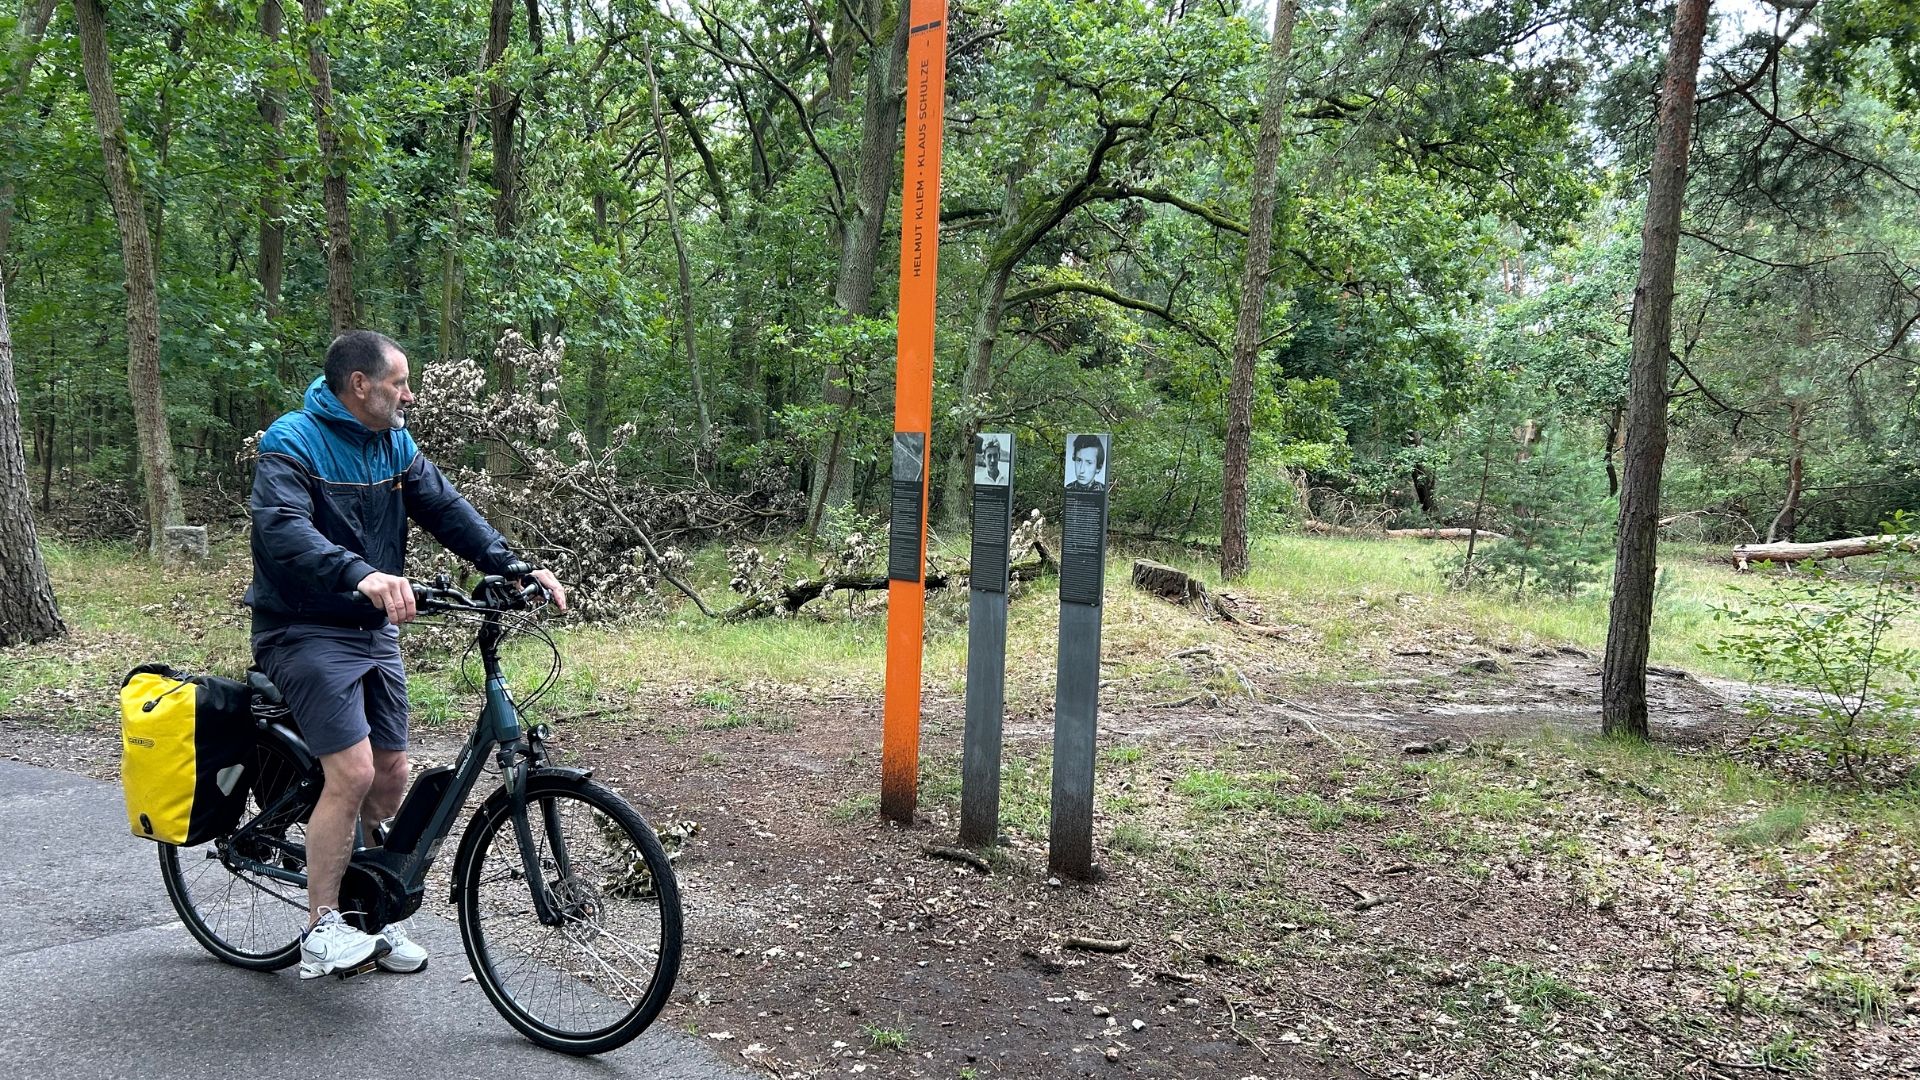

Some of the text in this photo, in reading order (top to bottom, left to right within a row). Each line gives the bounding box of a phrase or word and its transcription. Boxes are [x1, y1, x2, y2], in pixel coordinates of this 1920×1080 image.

[913, 58, 929, 277] HELMUT KLIEM KLAUS SCHULZE
